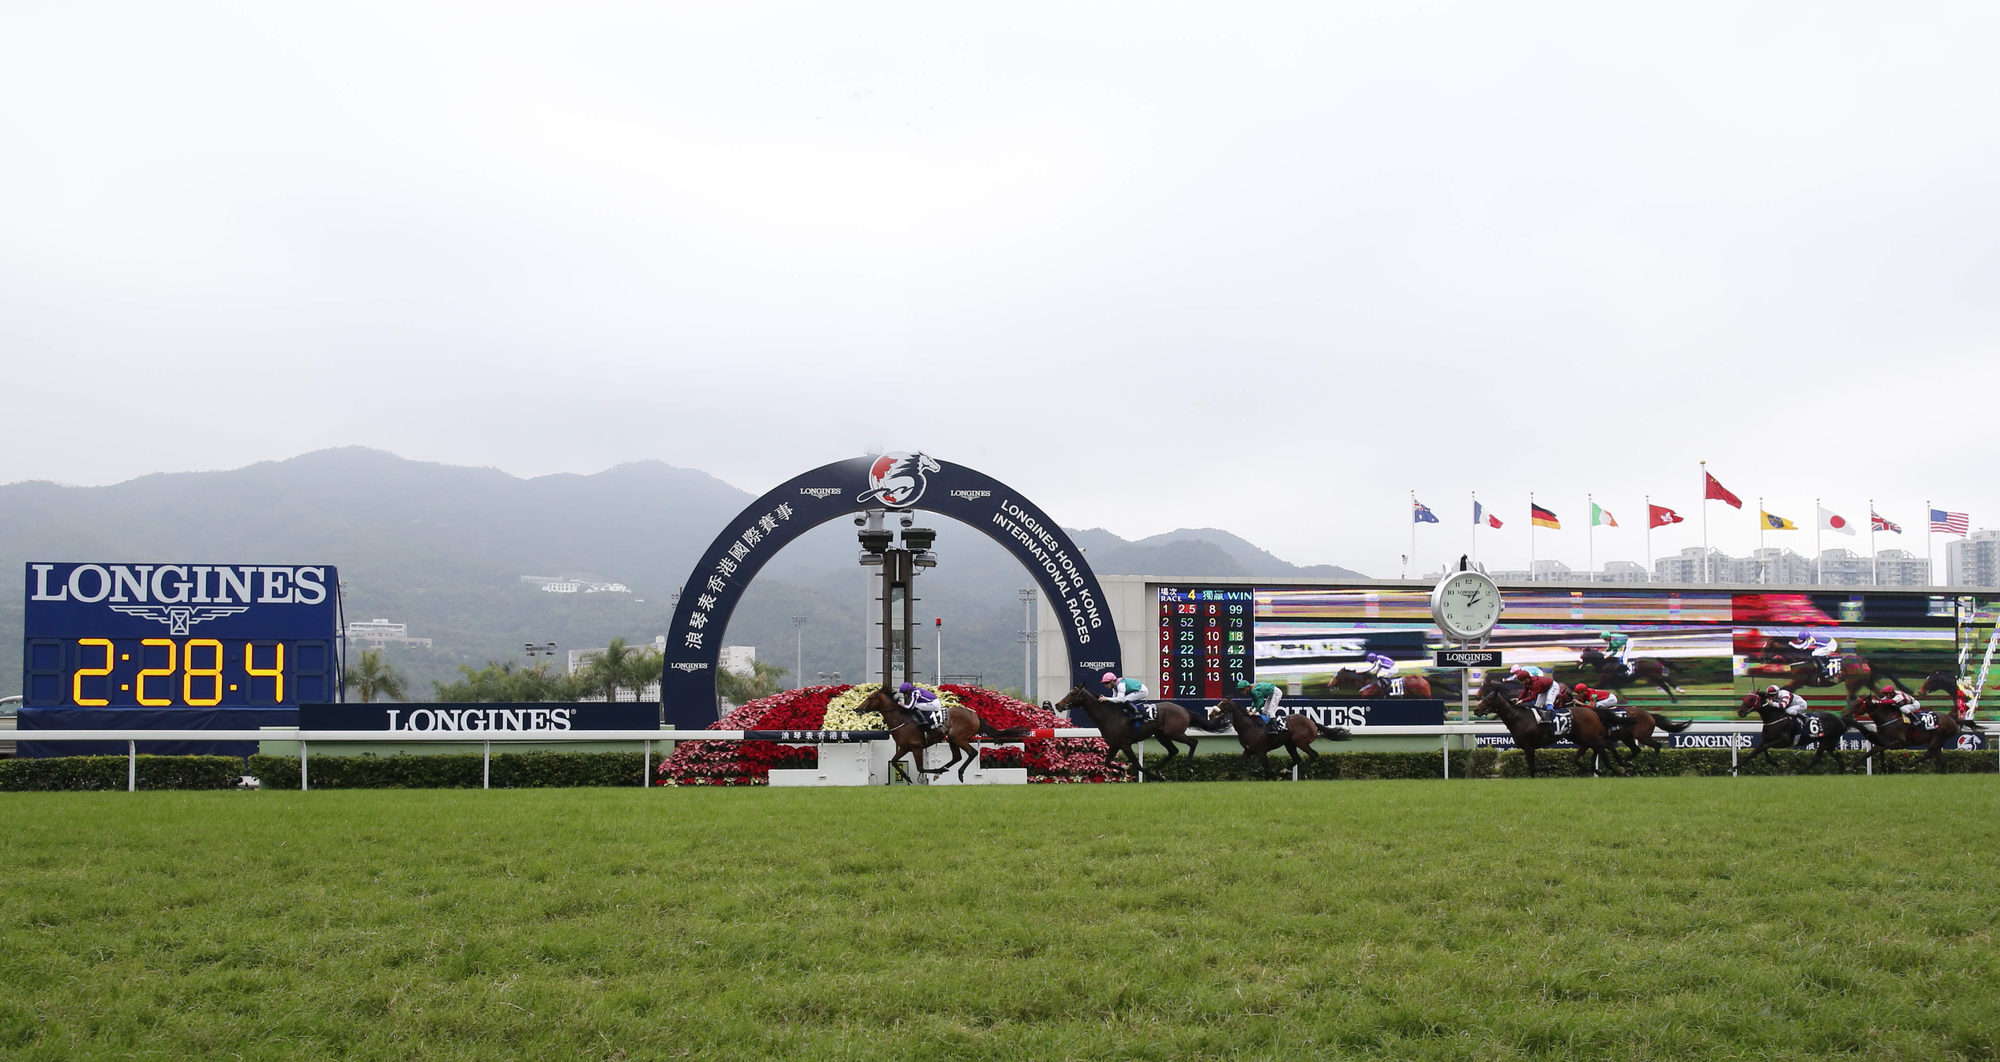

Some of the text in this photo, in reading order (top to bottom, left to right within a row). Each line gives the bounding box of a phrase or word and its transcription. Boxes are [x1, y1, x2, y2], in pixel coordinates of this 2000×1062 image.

[800, 487, 841, 495] LONGINES
[1000, 499, 1102, 629] LONGINES HONG KONG
[684, 501, 793, 650] 浪琴表香港國際賽事
[992, 512, 1091, 644] INTERNATIONAL RACES
[31, 564, 327, 604] LONGINES
[1187, 589, 1196, 600] 4
[1227, 591, 1252, 601] WIN
[1162, 604, 1168, 614] 1
[1178, 604, 1196, 614] 2.5
[1209, 604, 1216, 614] 8
[1229, 605, 1243, 615] 99
[1162, 617, 1170, 628] 2
[1180, 617, 1194, 628] 52
[1209, 618, 1216, 628] 9
[1229, 618, 1243, 628] 79
[1162, 631, 1170, 641] 3
[1180, 631, 1195, 641] 25
[1206, 631, 1220, 641] 10
[1230, 631, 1243, 641] 18
[1162, 645, 1169, 655] 4
[1180, 644, 1194, 655] 22
[1206, 645, 1219, 655] 11
[1227, 645, 1245, 655] 4.2
[1446, 653, 1493, 661] LONGINES
[1162, 658, 1170, 668] 5
[1180, 658, 1195, 668] 33
[1206, 658, 1220, 668] 12
[1229, 658, 1243, 668] 22
[73, 638, 285, 707] 2:28.4
[1162, 672, 1170, 682] 6
[1181, 672, 1193, 682] 11
[1206, 672, 1220, 682] 13
[1230, 672, 1244, 682] 10
[1163, 685, 1170, 695] 7
[1179, 685, 1197, 695] 7.2
[386, 708, 572, 731] LONGINES
[929, 710, 943, 725] 11
[1921, 714, 1935, 728] 10
[1553, 716, 1568, 732] 12
[1809, 719, 1819, 734] 6
